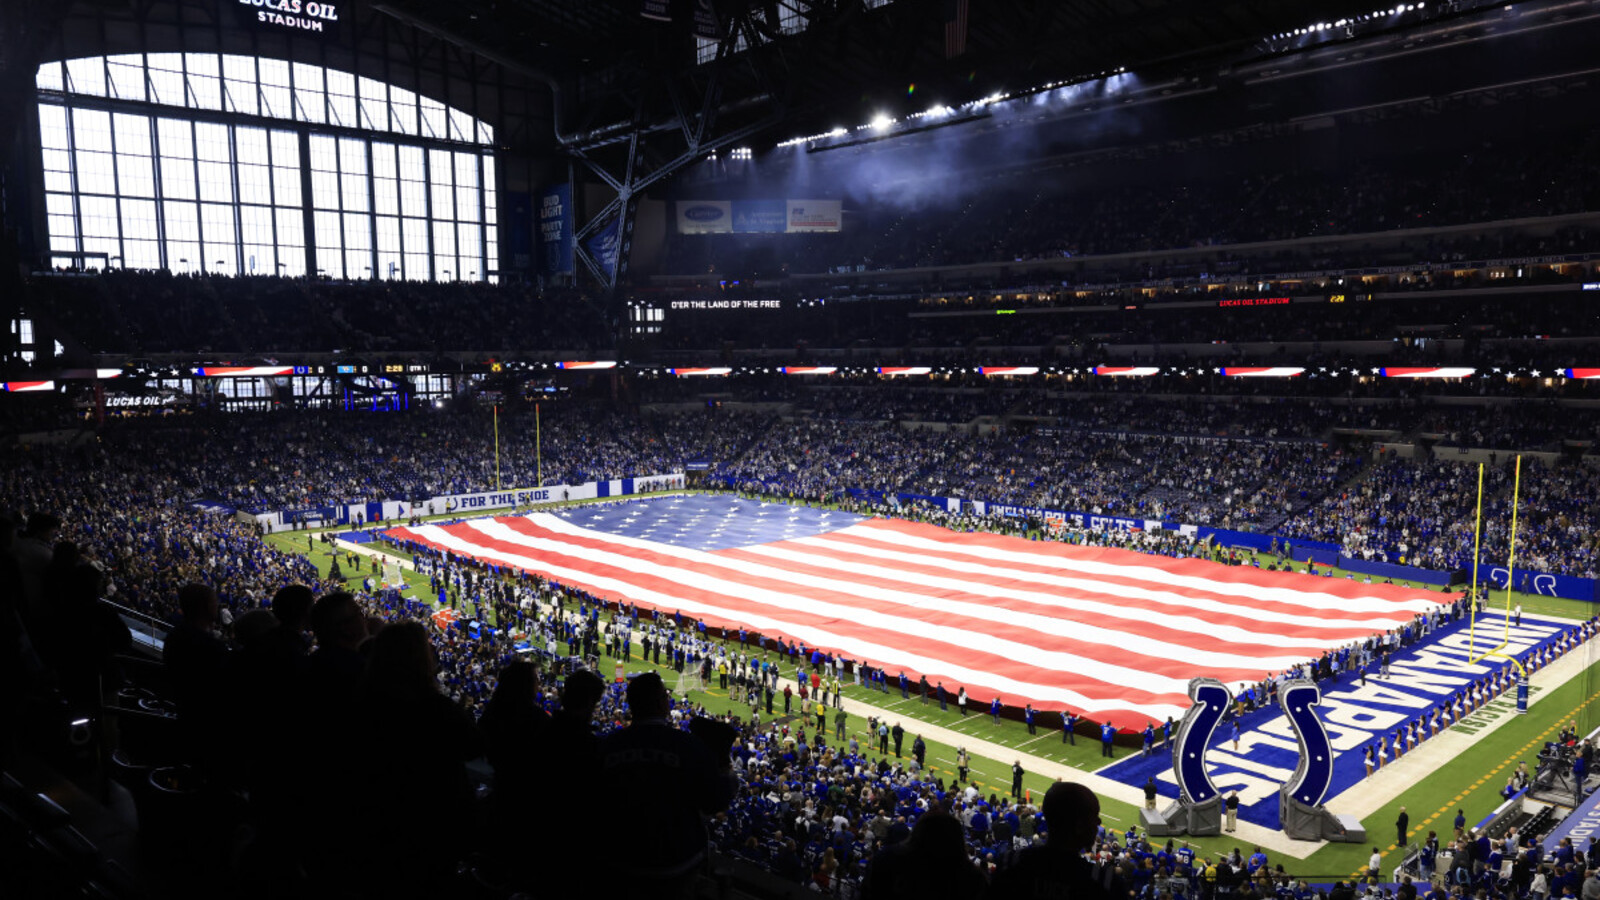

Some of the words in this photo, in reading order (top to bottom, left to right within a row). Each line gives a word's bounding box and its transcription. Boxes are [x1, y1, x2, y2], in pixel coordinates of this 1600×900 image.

[239, 0, 302, 13] CAS
[306, 2, 338, 21] OIL
[257, 11, 323, 32] STADIUM
[540, 205, 563, 219] LIGHT
[671, 301, 690, 309] O'ER
[690, 301, 706, 309] THE
[707, 300, 729, 308] LAND
[730, 300, 741, 308] OF
[743, 300, 758, 308] THE
[759, 300, 781, 308] FREE
[1219, 299, 1241, 307] LUCAS
[1254, 297, 1290, 305] STADIUM
[106, 397, 141, 407] LUCAS
[143, 396, 160, 406] OIL
[461, 497, 486, 508] FOR
[489, 493, 515, 505] THE
[1449, 700, 1518, 735] RACISM
